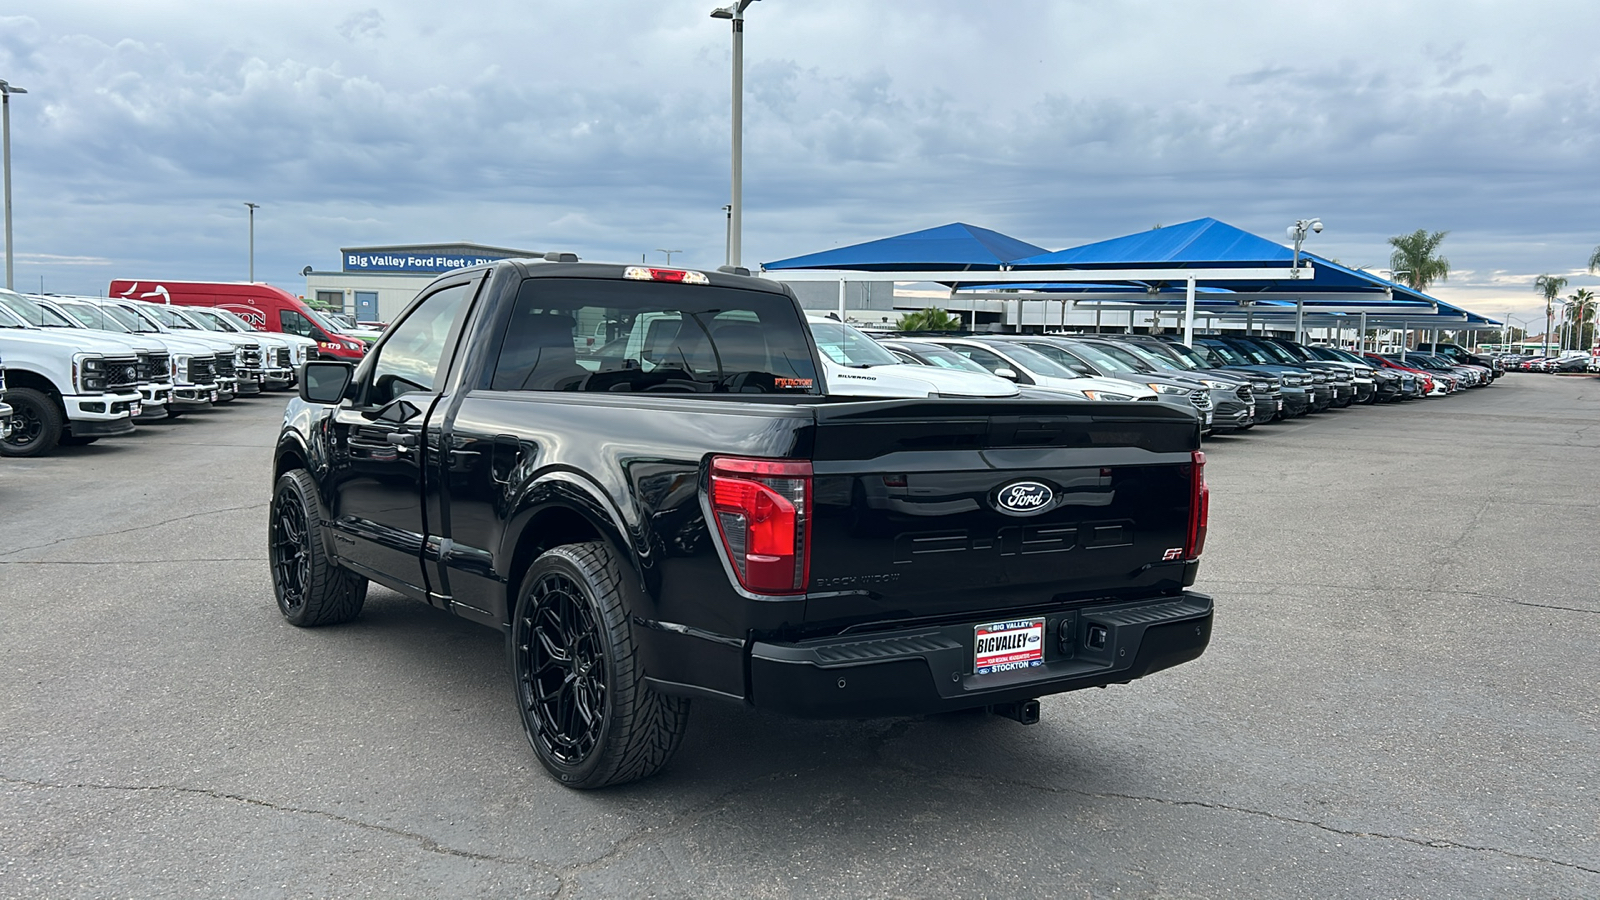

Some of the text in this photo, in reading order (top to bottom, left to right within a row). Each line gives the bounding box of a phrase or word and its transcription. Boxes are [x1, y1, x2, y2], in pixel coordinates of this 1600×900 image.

[348, 255, 368, 267] Big
[370, 255, 406, 268] Valley
[407, 257, 433, 267] Ford
[436, 257, 465, 268] Fleet
[327, 342, 341, 350] 179
[788, 378, 813, 386] FACTORY
[1007, 486, 1044, 507] Ford
[893, 518, 1136, 564] F-150
[816, 573, 900, 587] BLACK WIDOW
[977, 632, 1029, 654] BIGVALLEY
[992, 661, 1029, 672] STOCKTON
